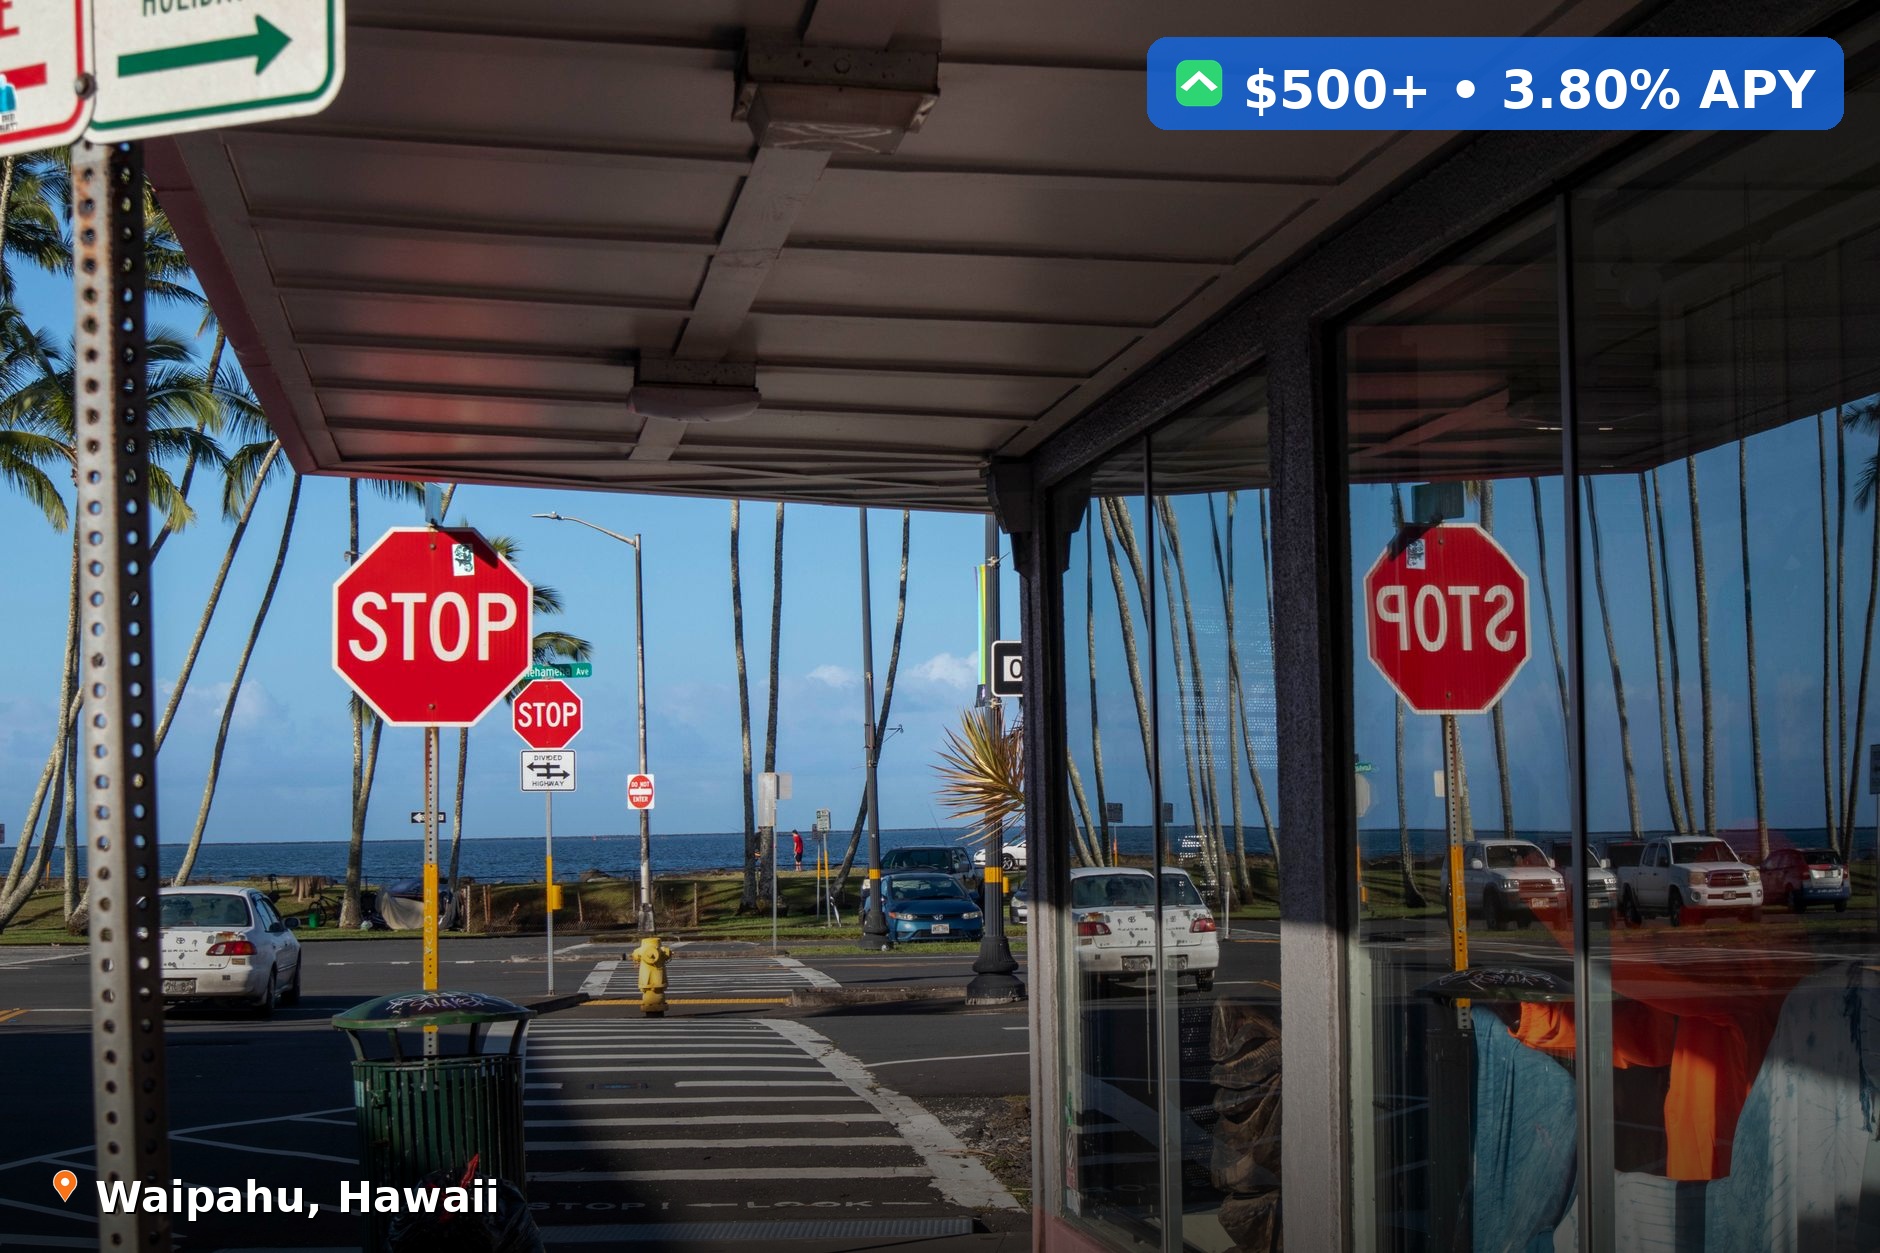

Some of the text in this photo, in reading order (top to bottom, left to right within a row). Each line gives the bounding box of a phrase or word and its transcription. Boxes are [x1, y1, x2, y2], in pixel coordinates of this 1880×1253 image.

[348, 591, 517, 662] STOP
[575, 667, 589, 676] Ave
[517, 702, 578, 728] STOP
